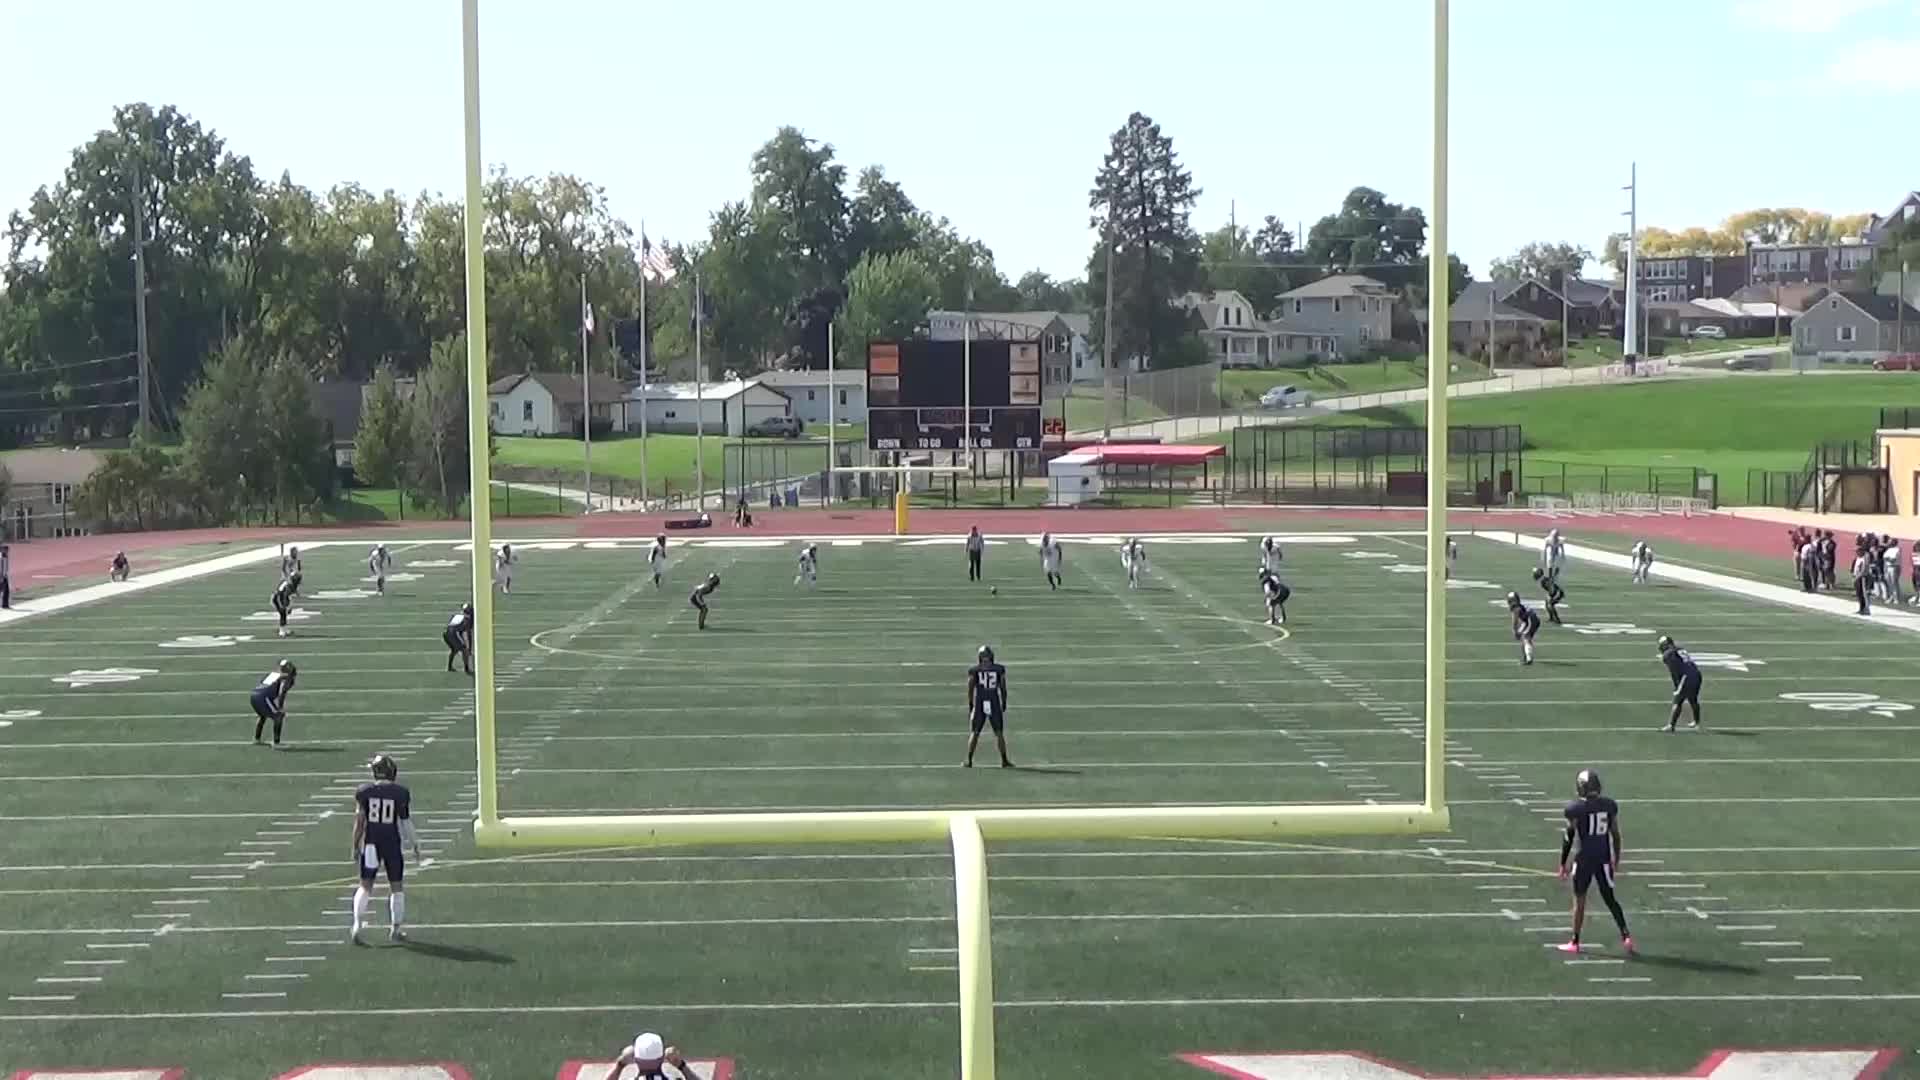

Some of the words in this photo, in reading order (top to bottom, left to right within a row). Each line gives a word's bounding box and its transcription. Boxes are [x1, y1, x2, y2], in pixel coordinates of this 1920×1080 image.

[958, 437, 978, 448] BLL
[978, 671, 997, 688] 42
[368, 797, 395, 824] 80
[1588, 811, 1609, 836] 16
